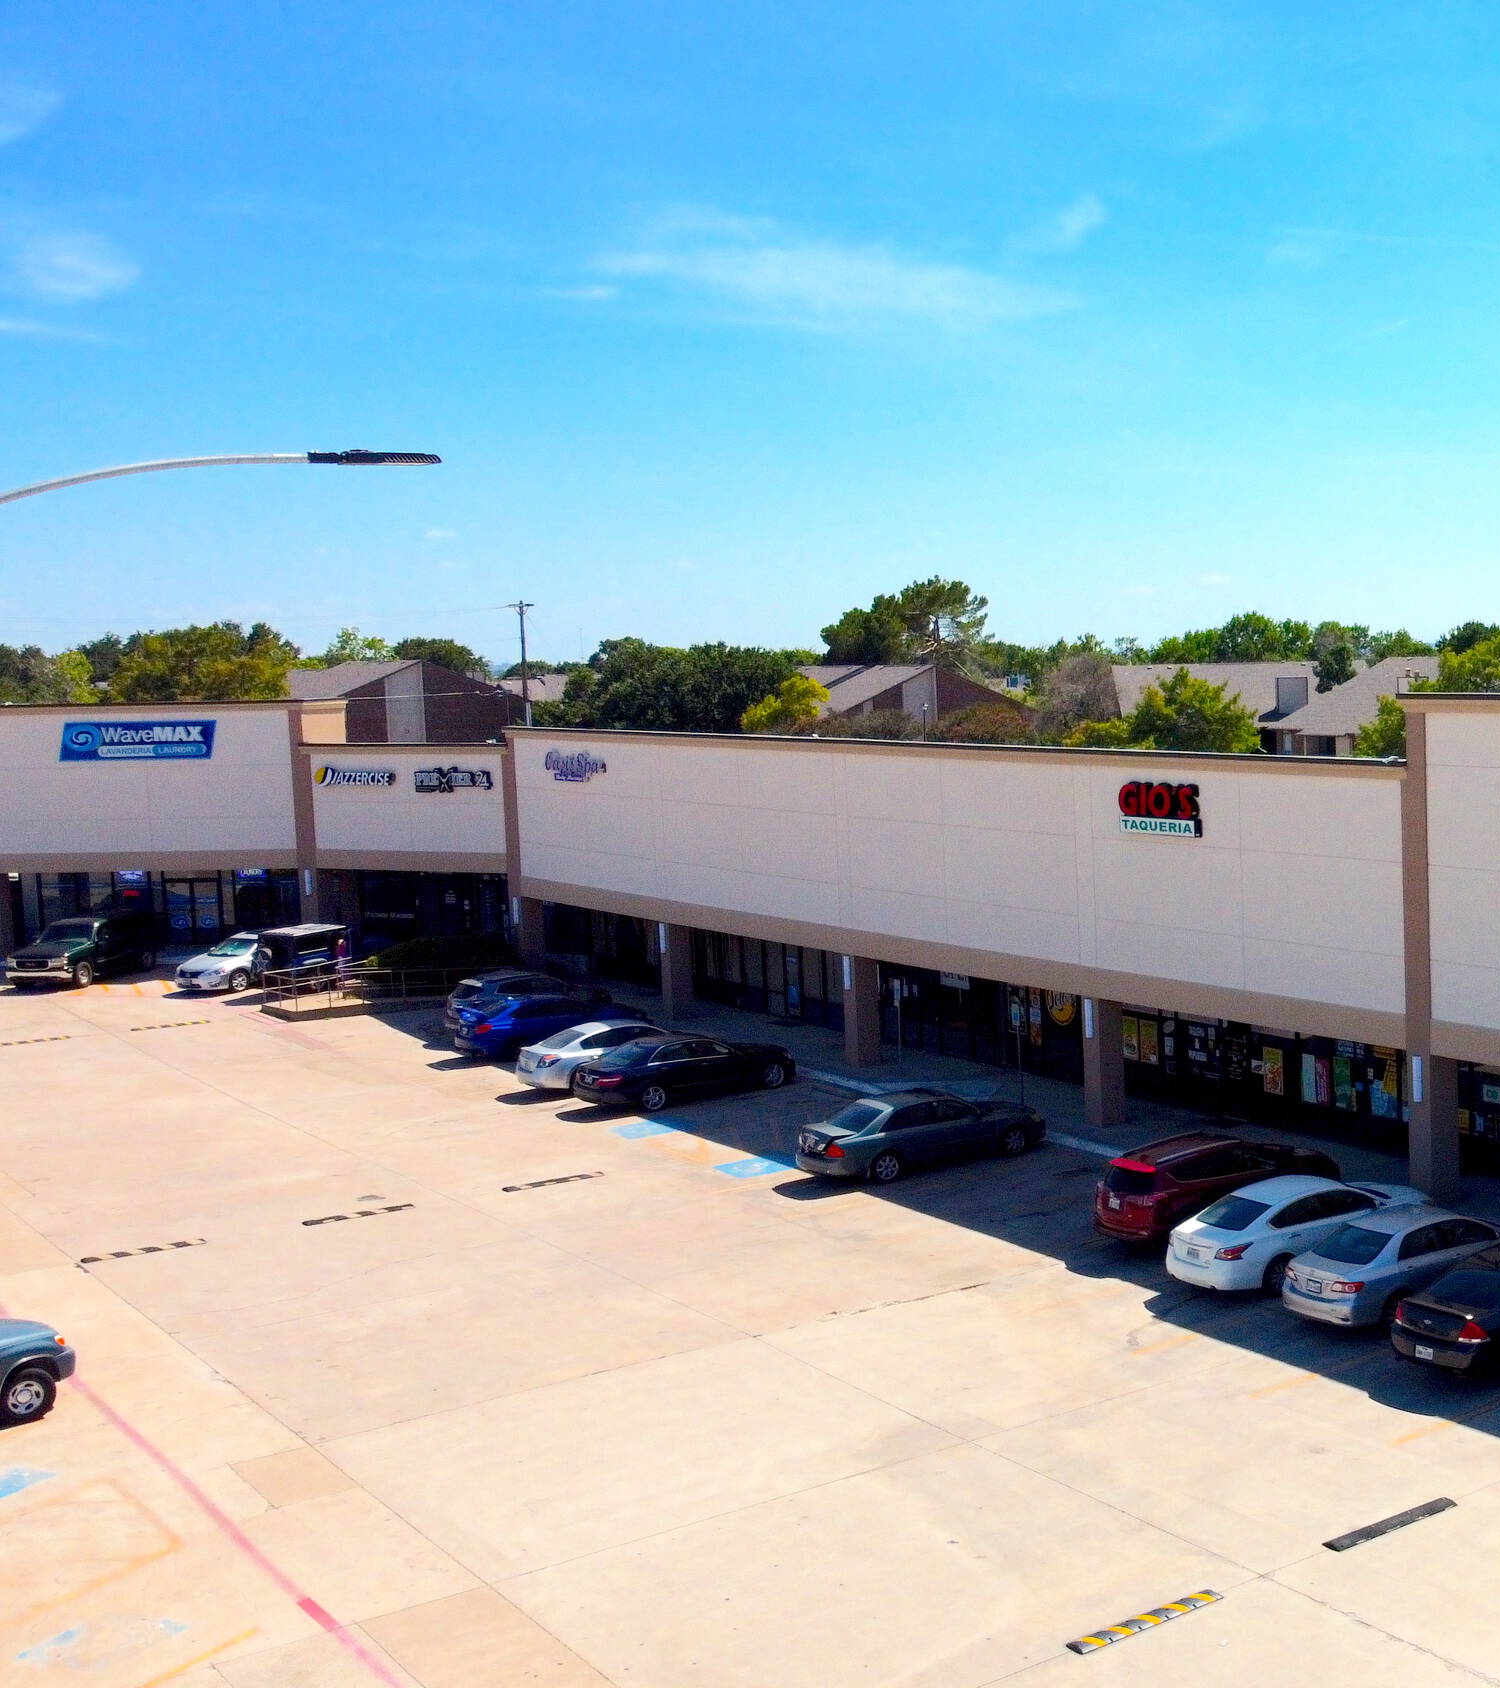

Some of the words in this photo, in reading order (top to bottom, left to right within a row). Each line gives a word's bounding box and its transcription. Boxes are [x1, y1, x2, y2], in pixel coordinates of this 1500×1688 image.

[100, 726, 204, 743] WaveMAX
[157, 746, 197, 754] LAUNDRY
[331, 771, 391, 786] JAZZERCISE
[1121, 819, 1193, 834] TAQUERIA
